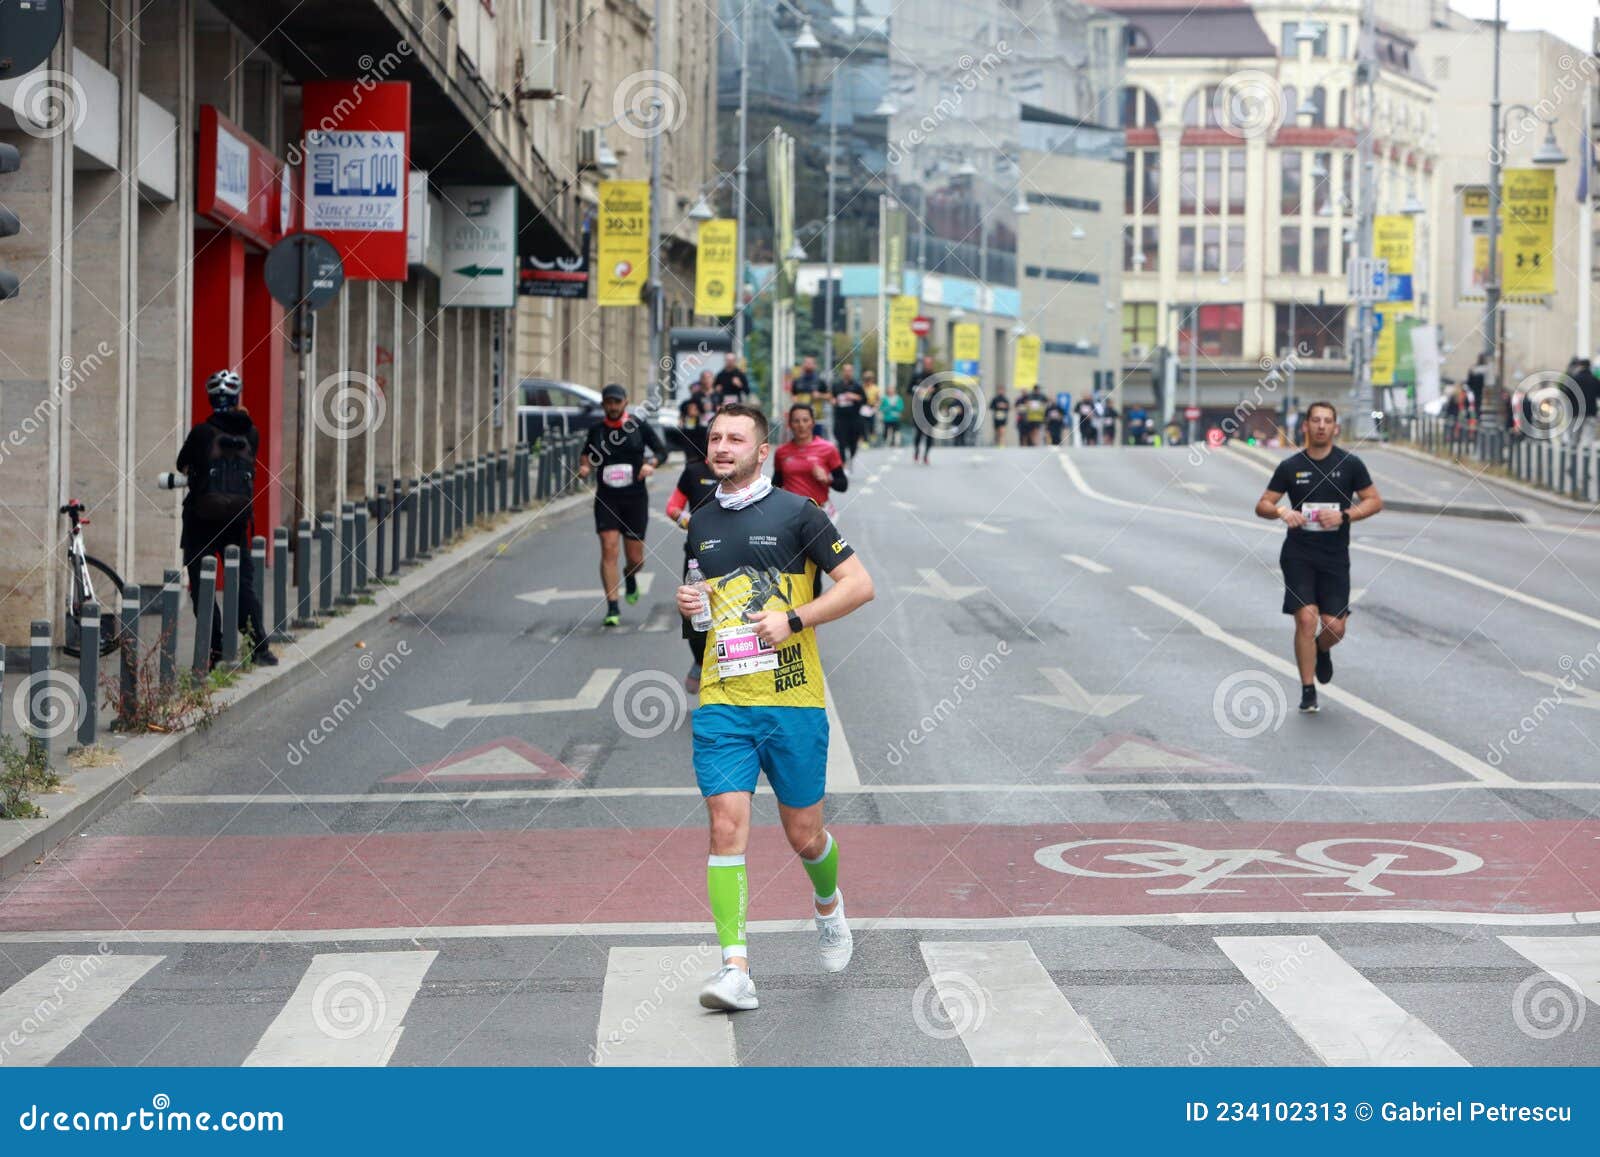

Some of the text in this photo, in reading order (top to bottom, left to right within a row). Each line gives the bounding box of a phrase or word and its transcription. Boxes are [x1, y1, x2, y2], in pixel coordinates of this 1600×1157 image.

[371, 132, 394, 149] SA
[315, 202, 392, 217] Since 1937
[775, 671, 807, 693] RACE
